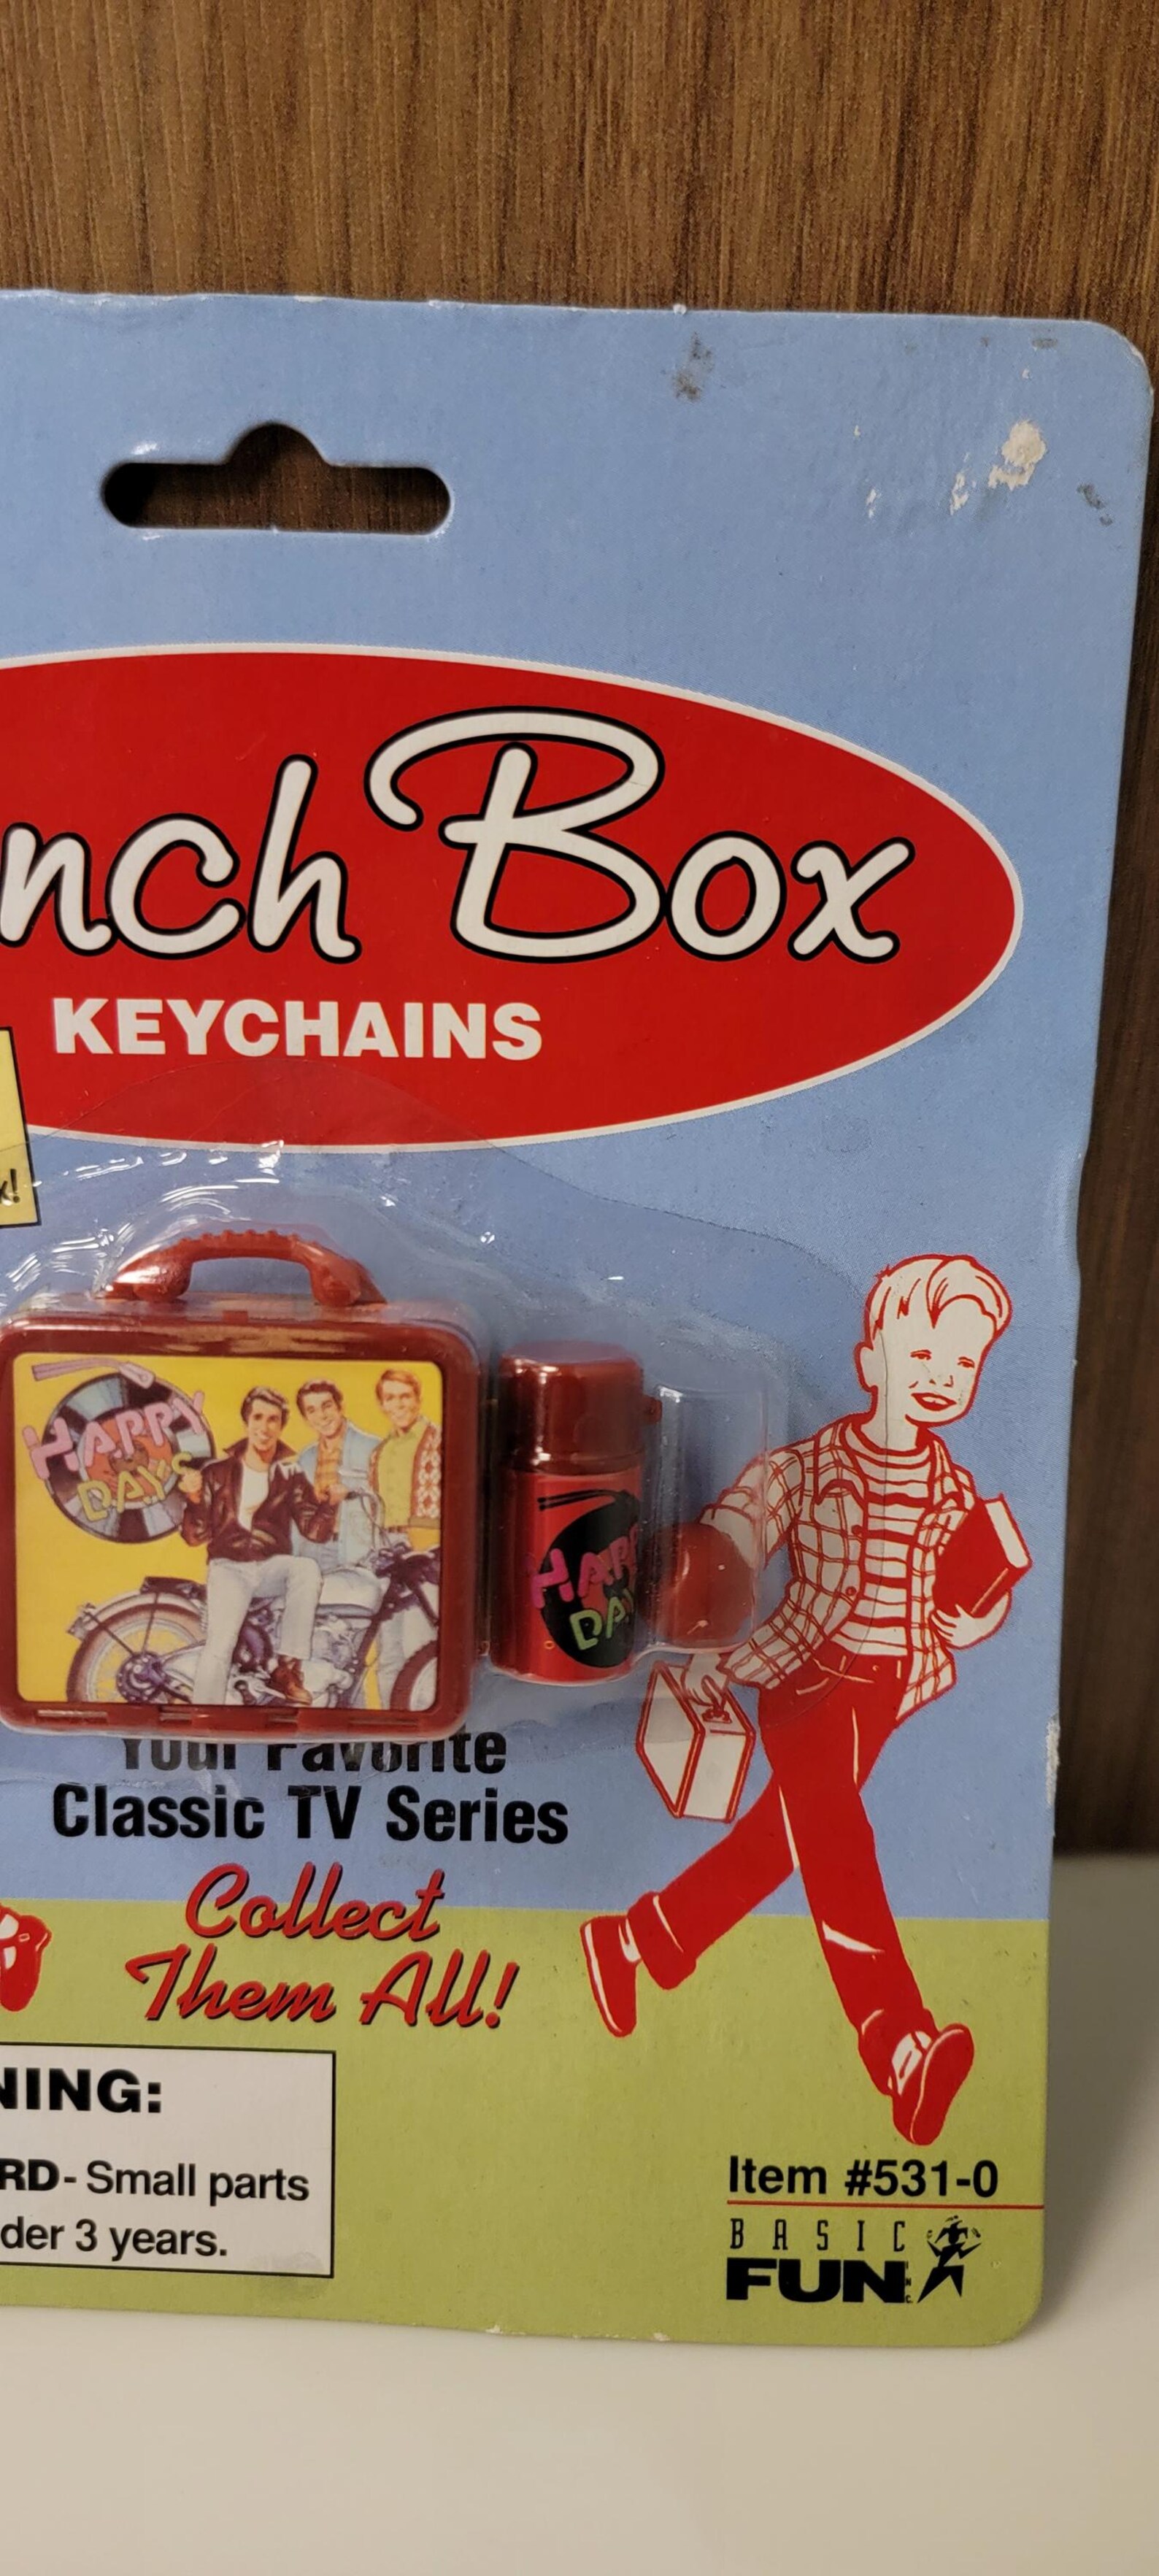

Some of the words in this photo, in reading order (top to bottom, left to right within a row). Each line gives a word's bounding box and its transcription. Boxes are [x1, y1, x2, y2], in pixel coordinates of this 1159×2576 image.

[364, 704, 916, 964] Box
[53, 997, 542, 1061] KEYCHAINS
[23, 1390, 207, 1480] HAPPY
[77, 1451, 193, 1522] DAYS
[52, 1782, 266, 1839] Classic
[288, 1785, 362, 1839] TV
[385, 1785, 569, 1845] Series
[184, 1862, 447, 1942] Collect
[124, 1942, 337, 2022] Them
[358, 1948, 520, 2030] All!
[86, 2159, 196, 2196] Small
[209, 2168, 310, 2207] parts
[729, 2156, 828, 2194] Item
[844, 2159, 998, 2198] #531-0
[0, 2215, 65, 2250] der
[74, 2218, 98, 2252] 3
[109, 2226, 228, 2261] years.
[730, 2218, 906, 2252] BASIC
[725, 2257, 906, 2304] FUN
